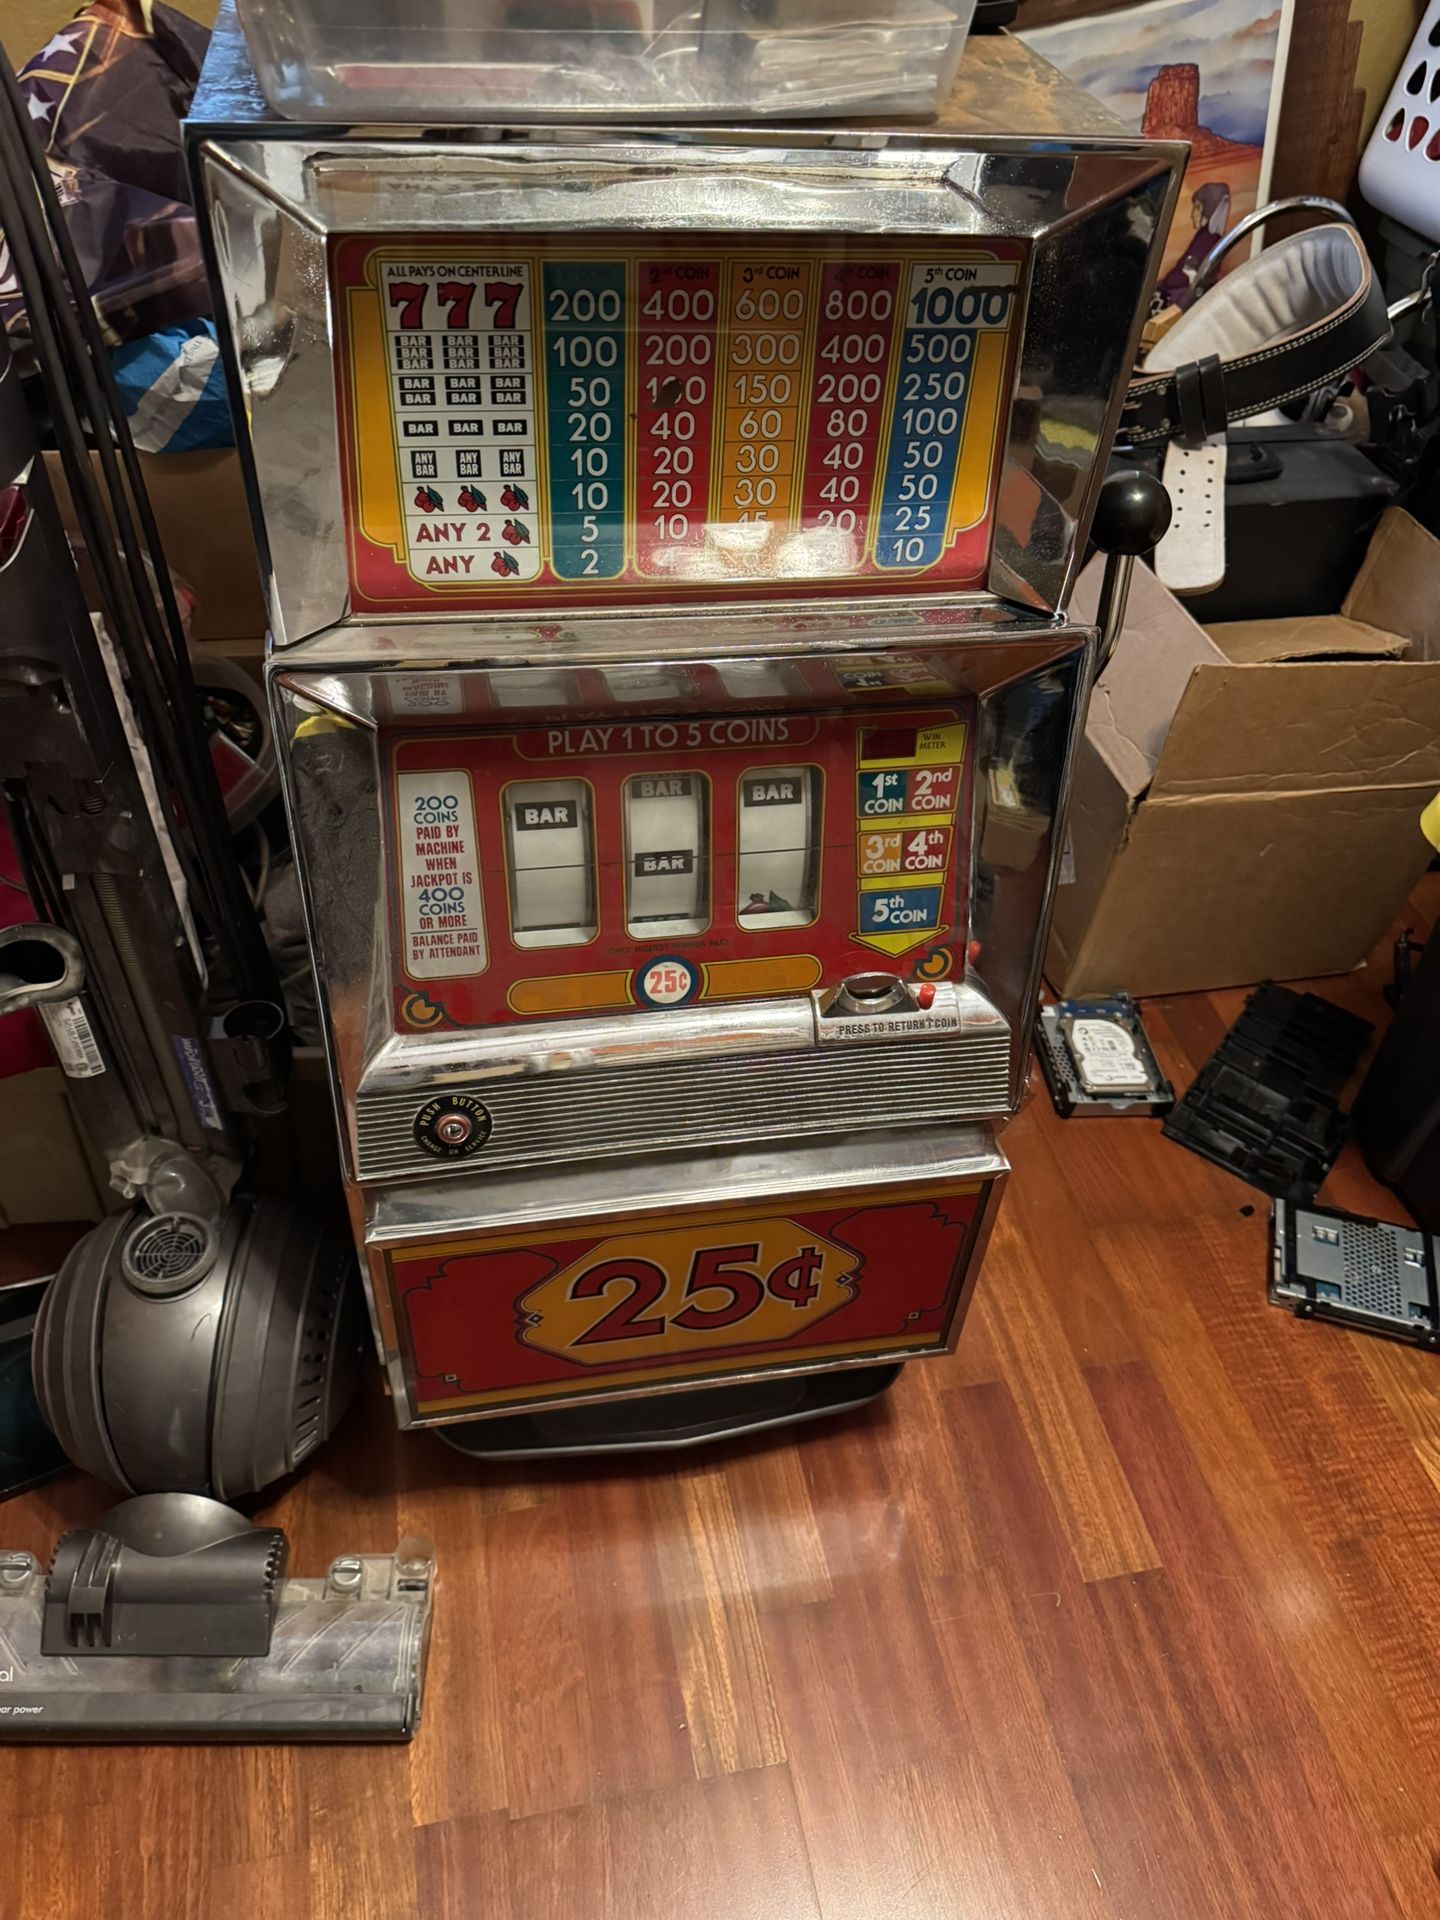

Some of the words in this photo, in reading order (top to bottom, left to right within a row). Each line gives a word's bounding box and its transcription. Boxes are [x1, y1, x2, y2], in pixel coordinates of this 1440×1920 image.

[387, 266, 406, 277] ALL
[408, 266, 435, 277] PAYS
[437, 266, 457, 277] ON
[675, 266, 710, 280] COIN
[766, 266, 800, 280] COIN
[924, 267, 943, 283] 5th
[945, 267, 978, 281] COIN
[388, 281, 429, 329] 7
[436, 281, 477, 329] 7
[484, 281, 524, 329] 7
[550, 289, 621, 322] 200
[642, 289, 714, 321] 400
[735, 288, 804, 321] 600
[825, 289, 892, 321] 800
[911, 286, 1009, 325] 1000
[400, 336, 426, 346] BAR
[447, 336, 473, 346] BAR
[493, 335, 519, 345] BAR
[402, 348, 428, 358] BAR
[448, 348, 474, 358] BAR
[494, 347, 519, 357] BAR
[553, 336, 617, 367] 100
[645, 334, 711, 365] 200
[732, 334, 799, 365] 300
[820, 334, 885, 364] 400
[906, 334, 971, 364] 500
[402, 359, 428, 369] BAR
[449, 359, 475, 369] BAR
[495, 359, 520, 369] BAR
[404, 378, 430, 389] BAR
[450, 378, 476, 388] BAR
[495, 377, 521, 388] BAR
[568, 377, 610, 407] 50
[734, 374, 791, 404] 150
[817, 373, 881, 403] 200
[903, 371, 965, 401] 250
[405, 393, 431, 404] BAR
[451, 393, 477, 403] BAR
[496, 393, 521, 403] BAR
[408, 423, 434, 434] BAR
[453, 422, 479, 433] BAR
[497, 422, 523, 433] BAR
[567, 412, 612, 442] 20
[650, 411, 695, 440] 40
[739, 409, 782, 439] 60
[826, 409, 868, 437] 80
[902, 407, 958, 435] 100
[415, 453, 434, 464] ANY
[459, 452, 478, 463] ANY
[503, 451, 521, 463] ANY
[570, 448, 608, 477] 10
[653, 446, 694, 475] 20
[736, 444, 779, 473] 30
[823, 442, 864, 470] 40
[903, 441, 943, 469] 50
[415, 464, 435, 476] BAR
[460, 464, 479, 475] BAR
[503, 463, 522, 474] BAR
[571, 482, 608, 511] 10
[652, 480, 692, 508] 20
[734, 478, 777, 506] 30
[819, 475, 860, 503] 40
[898, 474, 938, 501] 50
[580, 516, 599, 543] 5
[654, 513, 689, 540] 10
[894, 506, 931, 531] 25
[416, 523, 467, 542] ANY
[476, 523, 491, 541] 2
[580, 549, 599, 575] 2
[892, 537, 925, 562] 10
[426, 555, 476, 574] ANY
[547, 727, 615, 754] PLAY
[622, 726, 633, 750] 1
[639, 723, 679, 749] TO
[686, 722, 701, 747] 5
[709, 718, 790, 745] COINS
[919, 741, 946, 750] METER
[923, 733, 941, 742] WIN
[640, 779, 683, 797] BAR
[752, 783, 794, 802] BAR
[872, 772, 899, 798] 1st
[914, 767, 953, 796] 2nd
[414, 795, 458, 811] 200
[524, 806, 569, 825] BAR
[864, 798, 903, 814] COIN
[911, 794, 951, 811] COIN
[413, 810, 458, 825] COINS
[416, 826, 441, 840] PAID
[446, 825, 460, 838] BY
[865, 833, 900, 861] 3rd
[907, 829, 944, 857] 4th
[415, 841, 465, 856] MACHINE
[425, 857, 457, 871] WHEN
[643, 855, 685, 872] BAR
[863, 858, 901, 874] COIN
[905, 854, 943, 870] COIN
[410, 873, 458, 888] JACKPOT
[462, 872, 473, 885] IS
[418, 887, 465, 902] 400
[419, 902, 465, 916] COINS
[872, 895, 905, 924] 5th
[890, 908, 928, 924] COIN
[419, 916, 433, 930] OR
[438, 914, 467, 928] MORE
[412, 933, 454, 947] BALANCE
[457, 931, 478, 944] PAID
[412, 948, 424, 961] BY
[429, 945, 481, 959] ATTENDANT
[649, 968, 688, 995] 25¢
[839, 1023, 871, 1036] PRESS
[872, 1022, 885, 1033] TO
[888, 1019, 925, 1032] RETURN
[935, 1017, 958, 1029] COIN
[419, 1102, 441, 1127] PUSH
[452, 1096, 487, 1122] BUTTON
[565, 1240, 824, 1348] 25¢
[0, 1706, 12, 1714] ar
[12, 1706, 44, 1716] power
